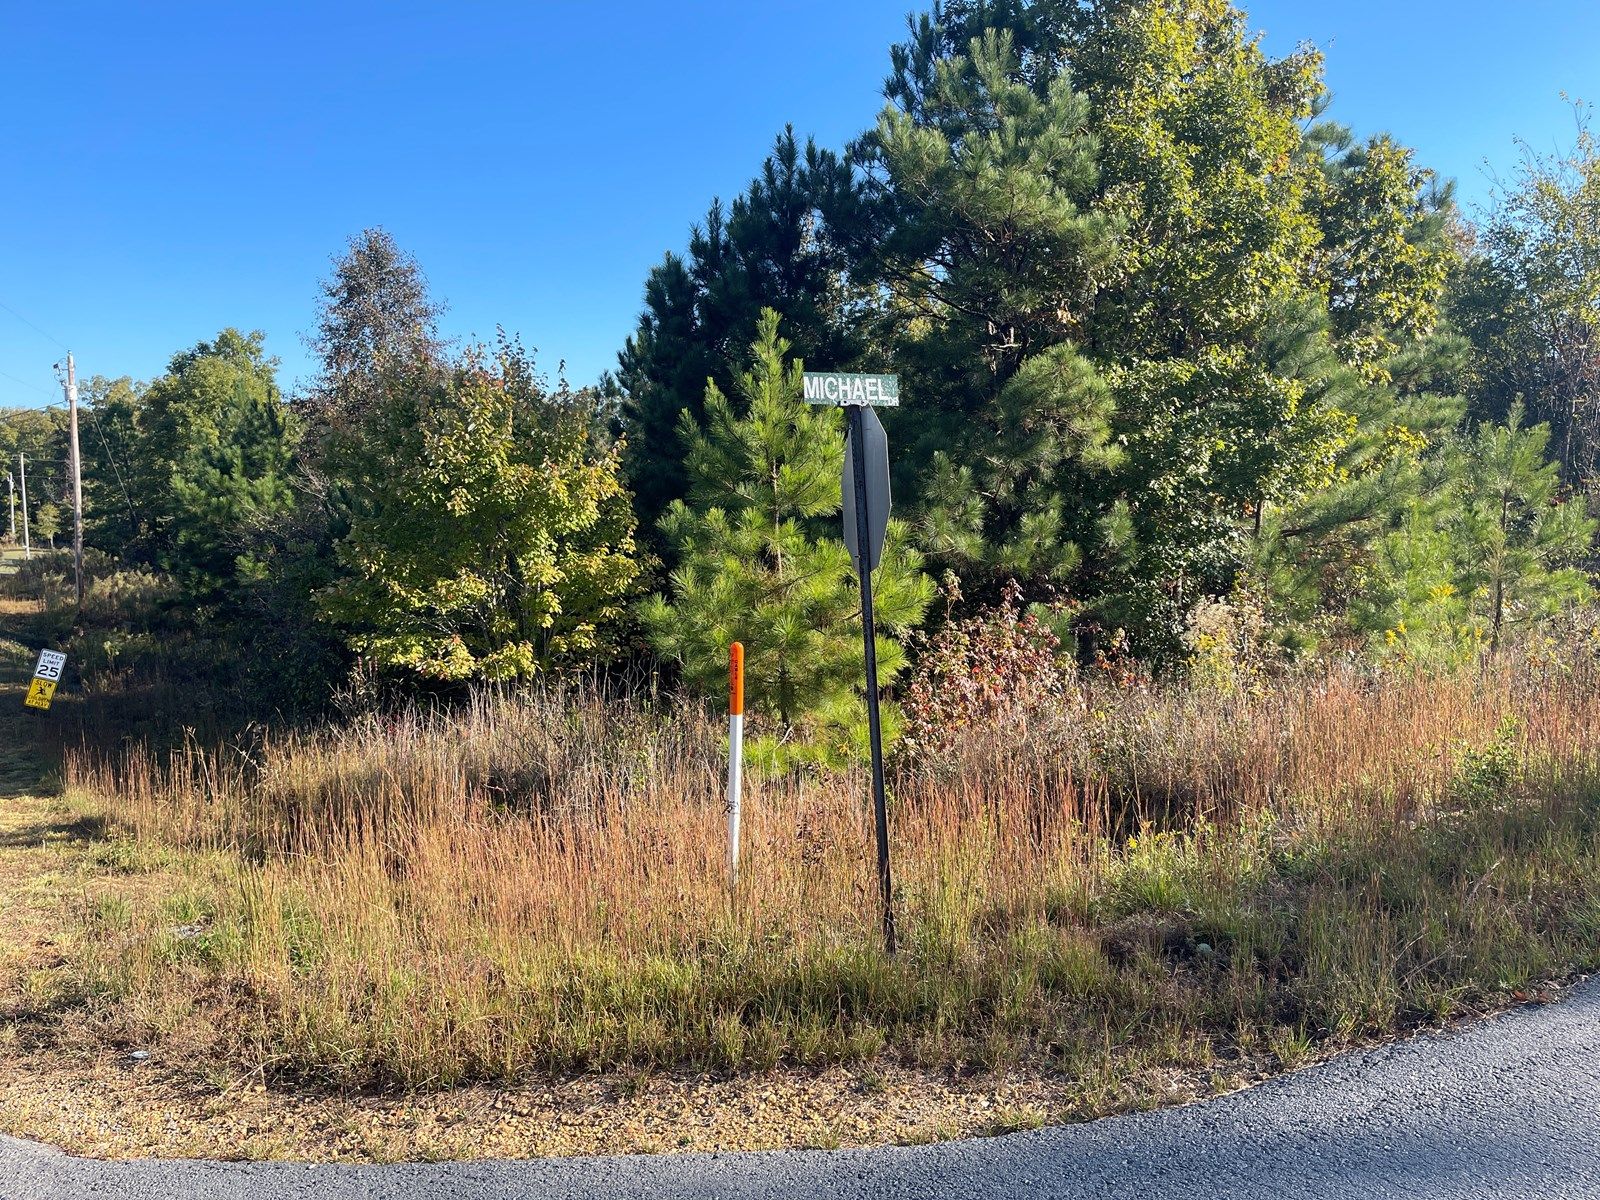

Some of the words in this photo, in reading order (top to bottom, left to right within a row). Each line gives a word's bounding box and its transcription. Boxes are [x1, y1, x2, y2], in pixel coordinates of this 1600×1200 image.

[803, 376, 889, 400] MICHAEL
[889, 396, 900, 406] DR
[43, 652, 64, 661] SPEED
[37, 665, 60, 677] 25
[35, 680, 52, 688] SLOW
